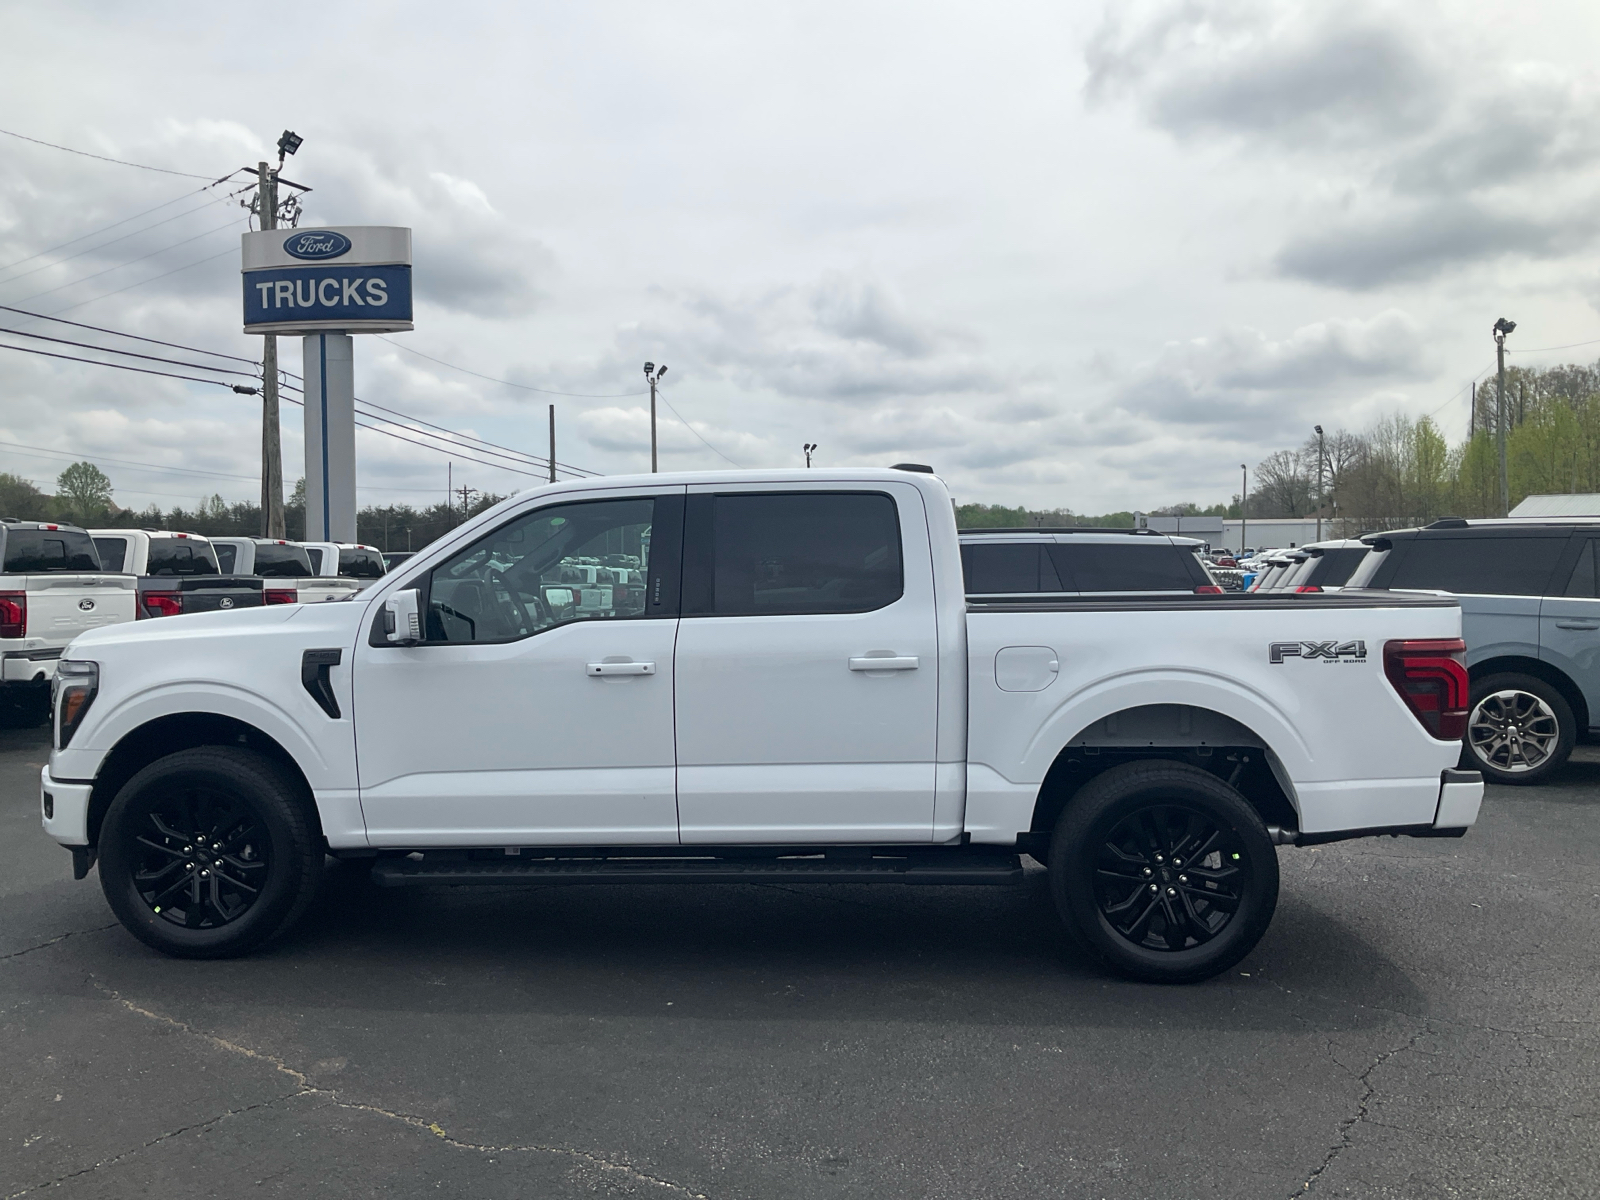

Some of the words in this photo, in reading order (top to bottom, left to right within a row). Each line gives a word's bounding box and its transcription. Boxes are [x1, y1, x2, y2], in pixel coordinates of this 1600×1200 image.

[297, 235, 334, 253] Ford
[256, 278, 389, 309] TRUCKS
[1269, 640, 1367, 664] FX4
